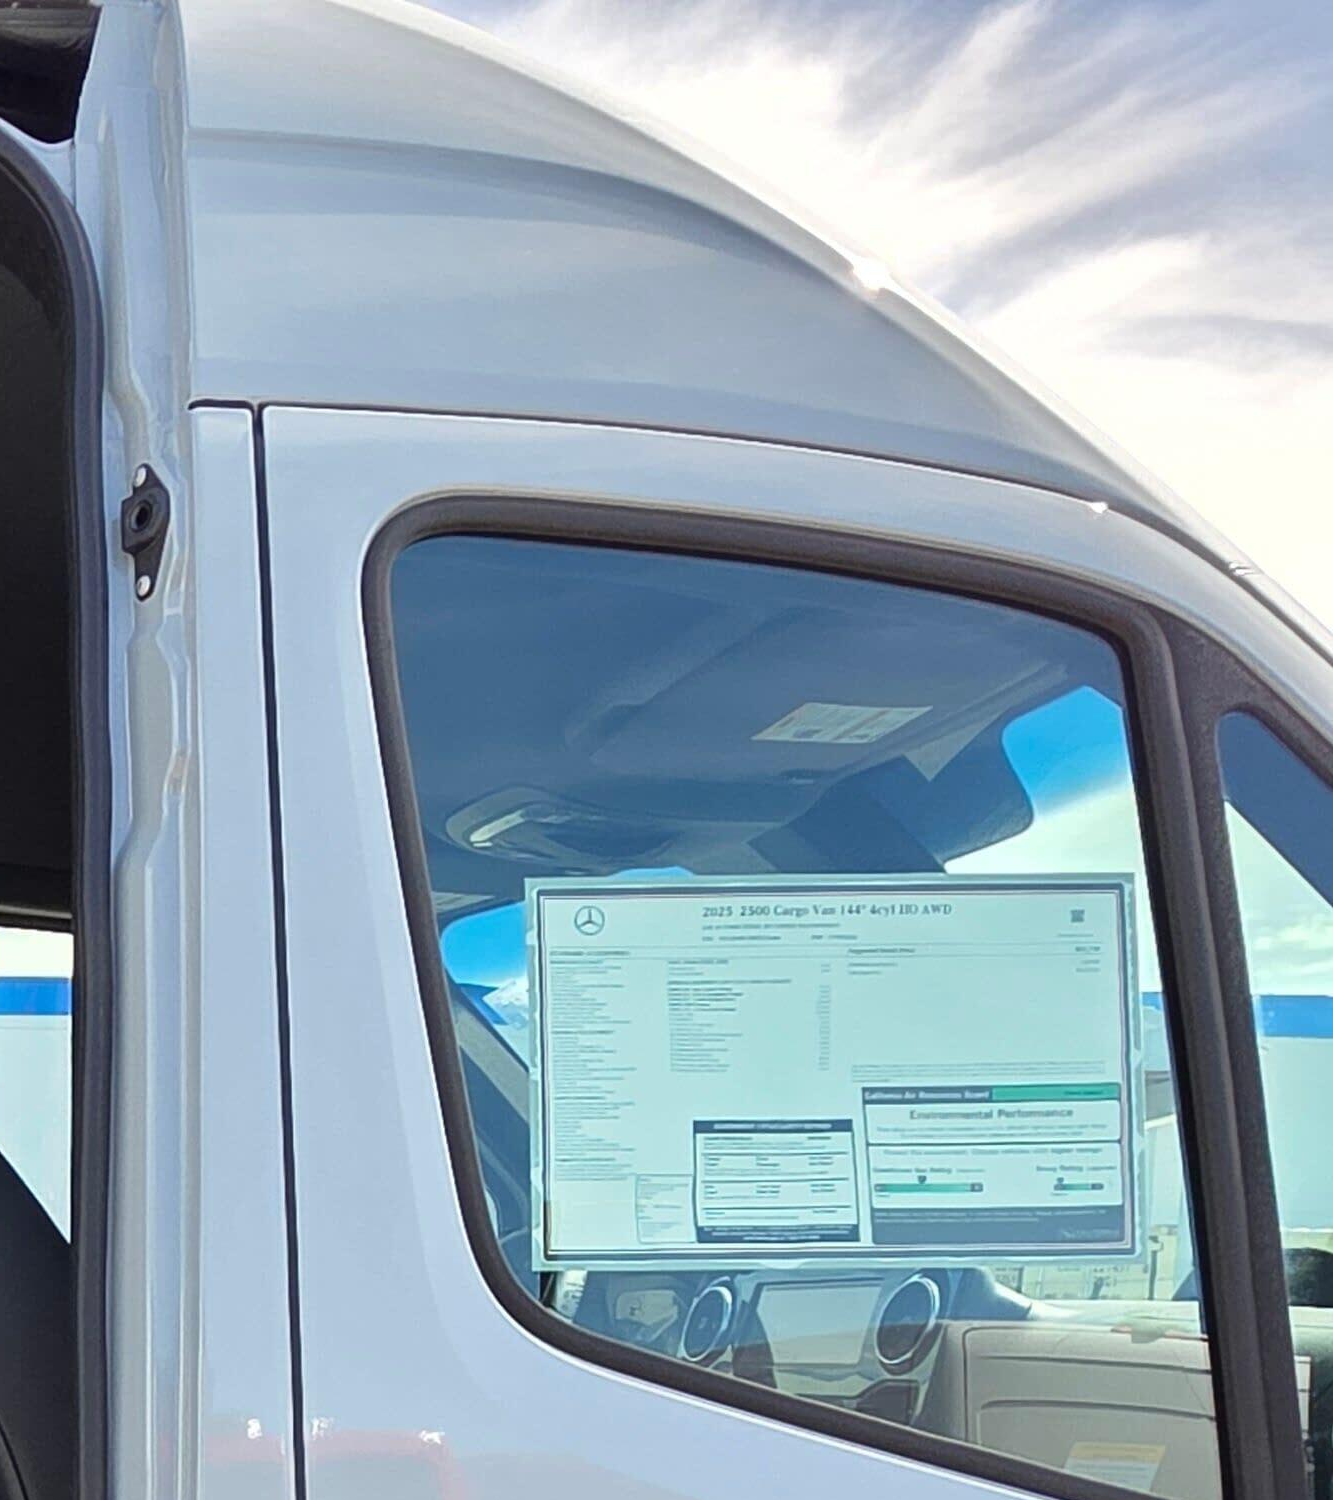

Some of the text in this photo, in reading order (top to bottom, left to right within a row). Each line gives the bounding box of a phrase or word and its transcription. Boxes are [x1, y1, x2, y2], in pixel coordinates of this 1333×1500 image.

[740, 905, 771, 917] 2500
[773, 904, 810, 918] Cargo
[812, 904, 836, 916] Van
[922, 904, 952, 915] AWD
